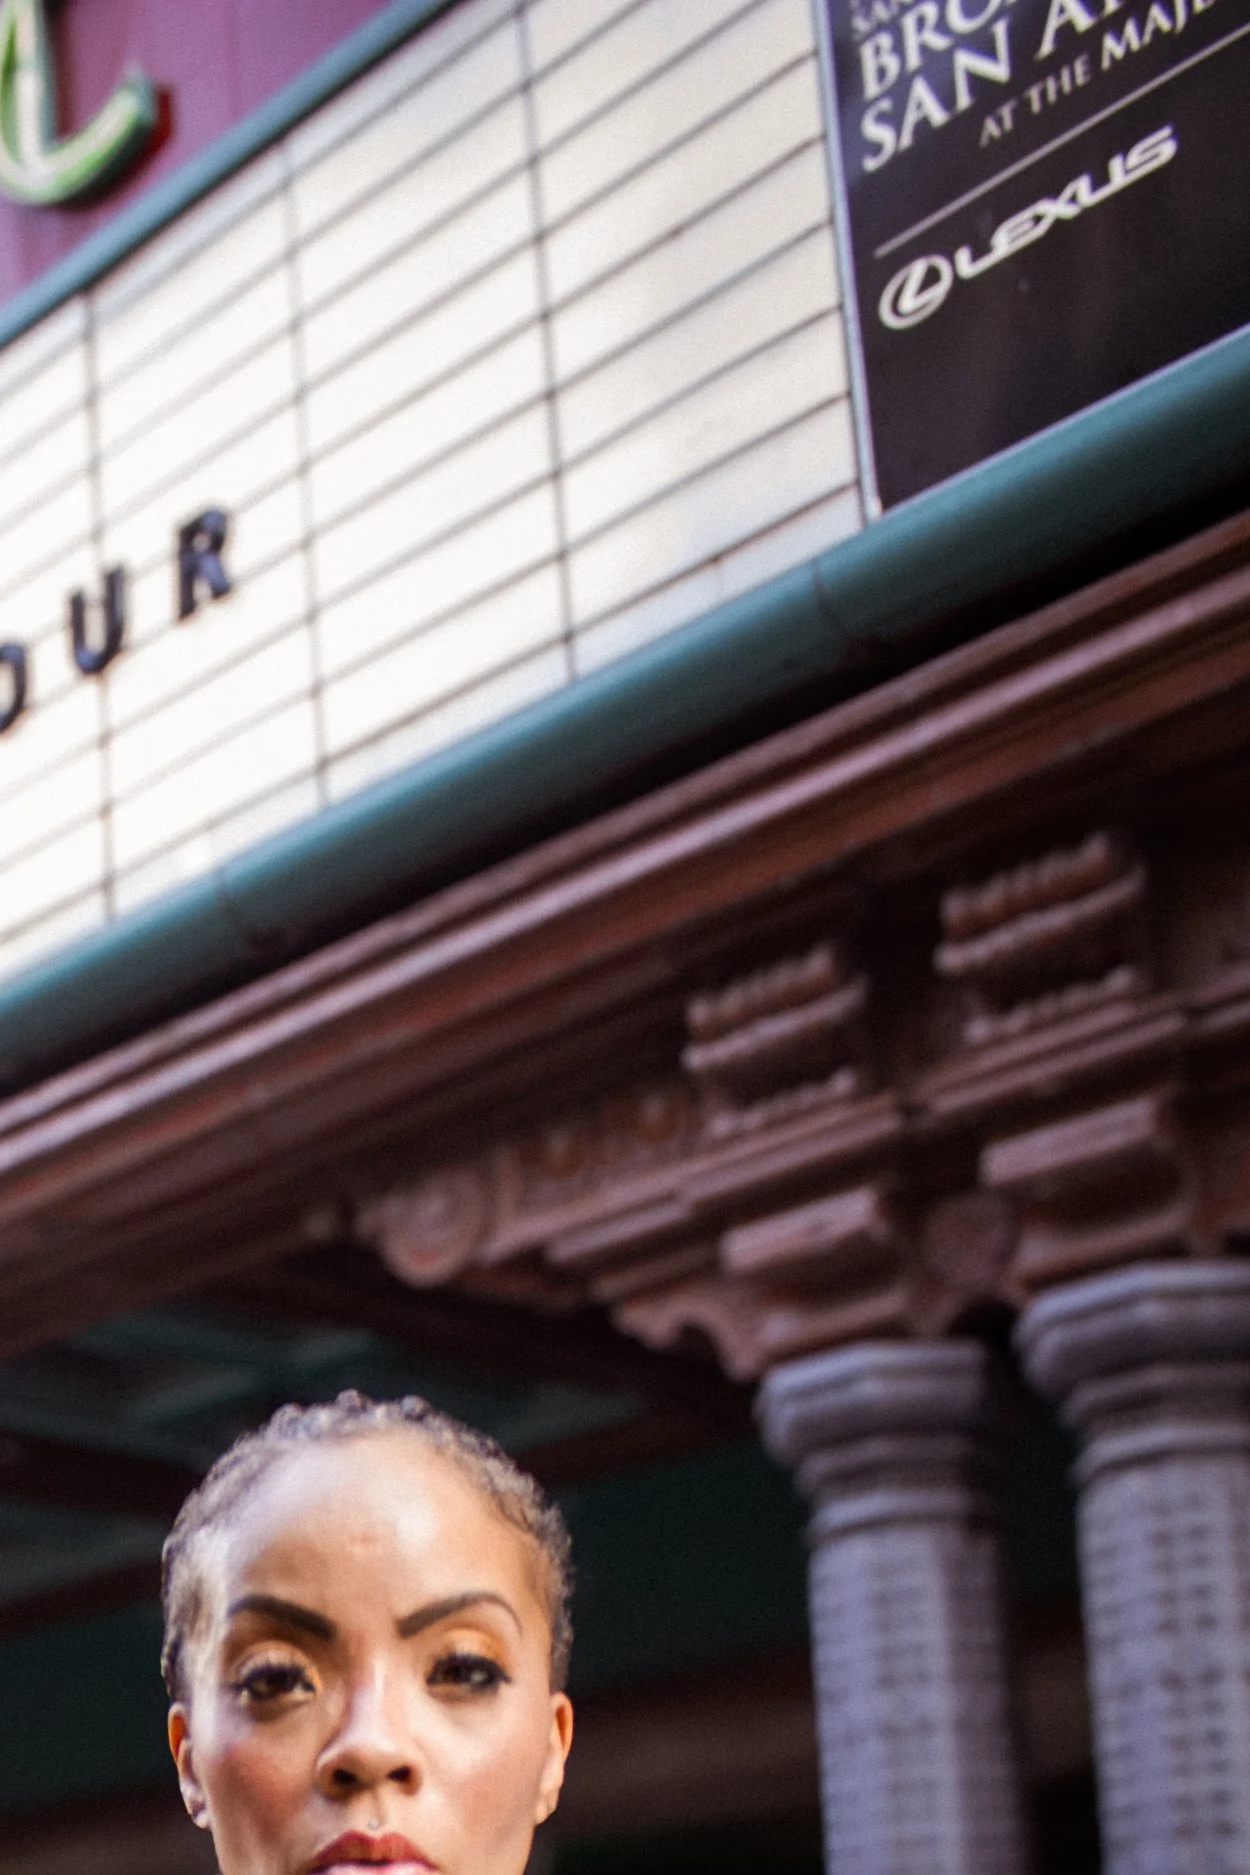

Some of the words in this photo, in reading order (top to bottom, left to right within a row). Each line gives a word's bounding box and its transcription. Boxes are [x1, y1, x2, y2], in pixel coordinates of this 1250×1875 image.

[859, 0, 1016, 101] BRO
[860, 17, 1012, 173] SAN
[978, 99, 1018, 148] AT
[1024, 53, 1092, 115] THE
[953, 123, 1180, 280] LEXUS
